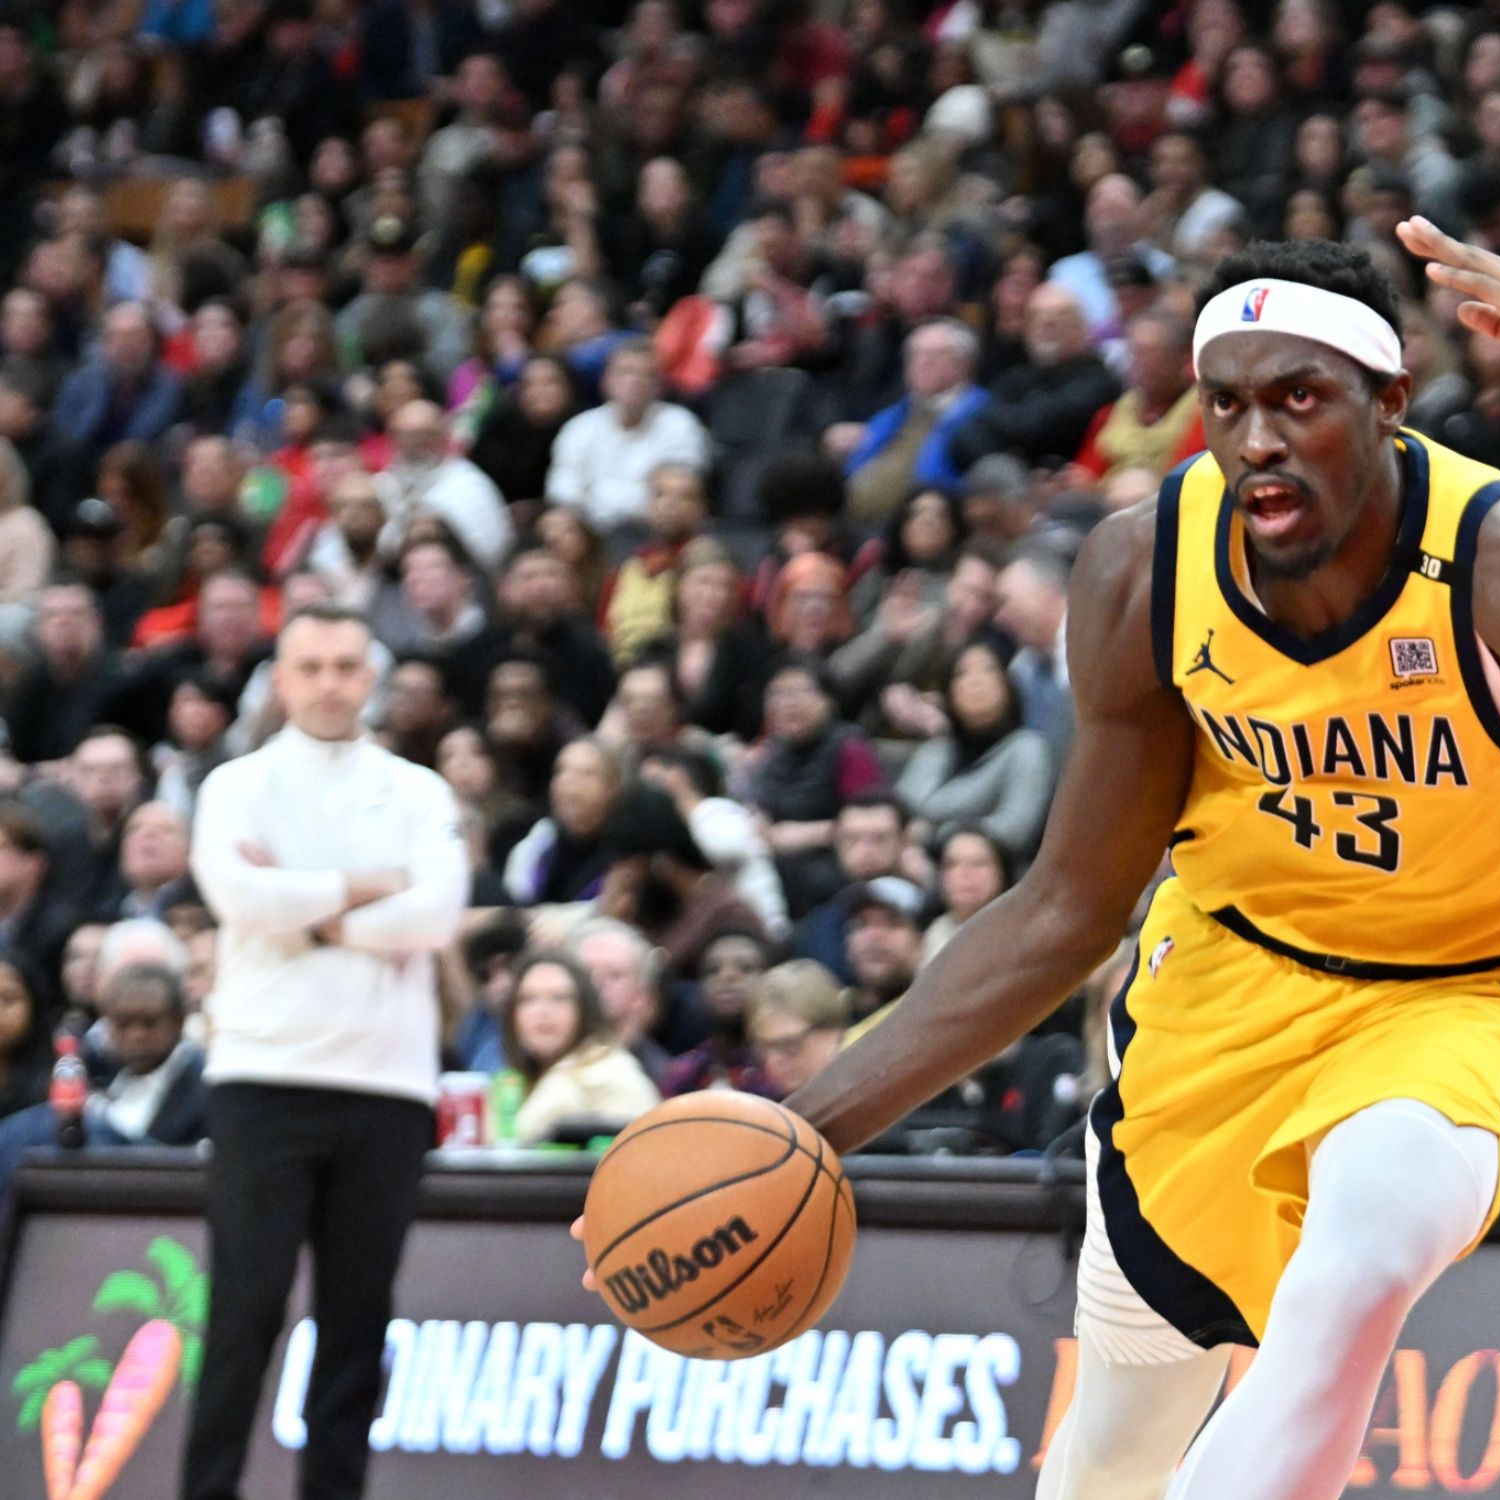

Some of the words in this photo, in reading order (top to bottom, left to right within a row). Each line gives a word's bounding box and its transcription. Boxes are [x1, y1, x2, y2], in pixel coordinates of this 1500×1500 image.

[1185, 700, 1469, 786] NDIANA
[1257, 787, 1400, 873] 43
[604, 1214, 759, 1314] Wilson
